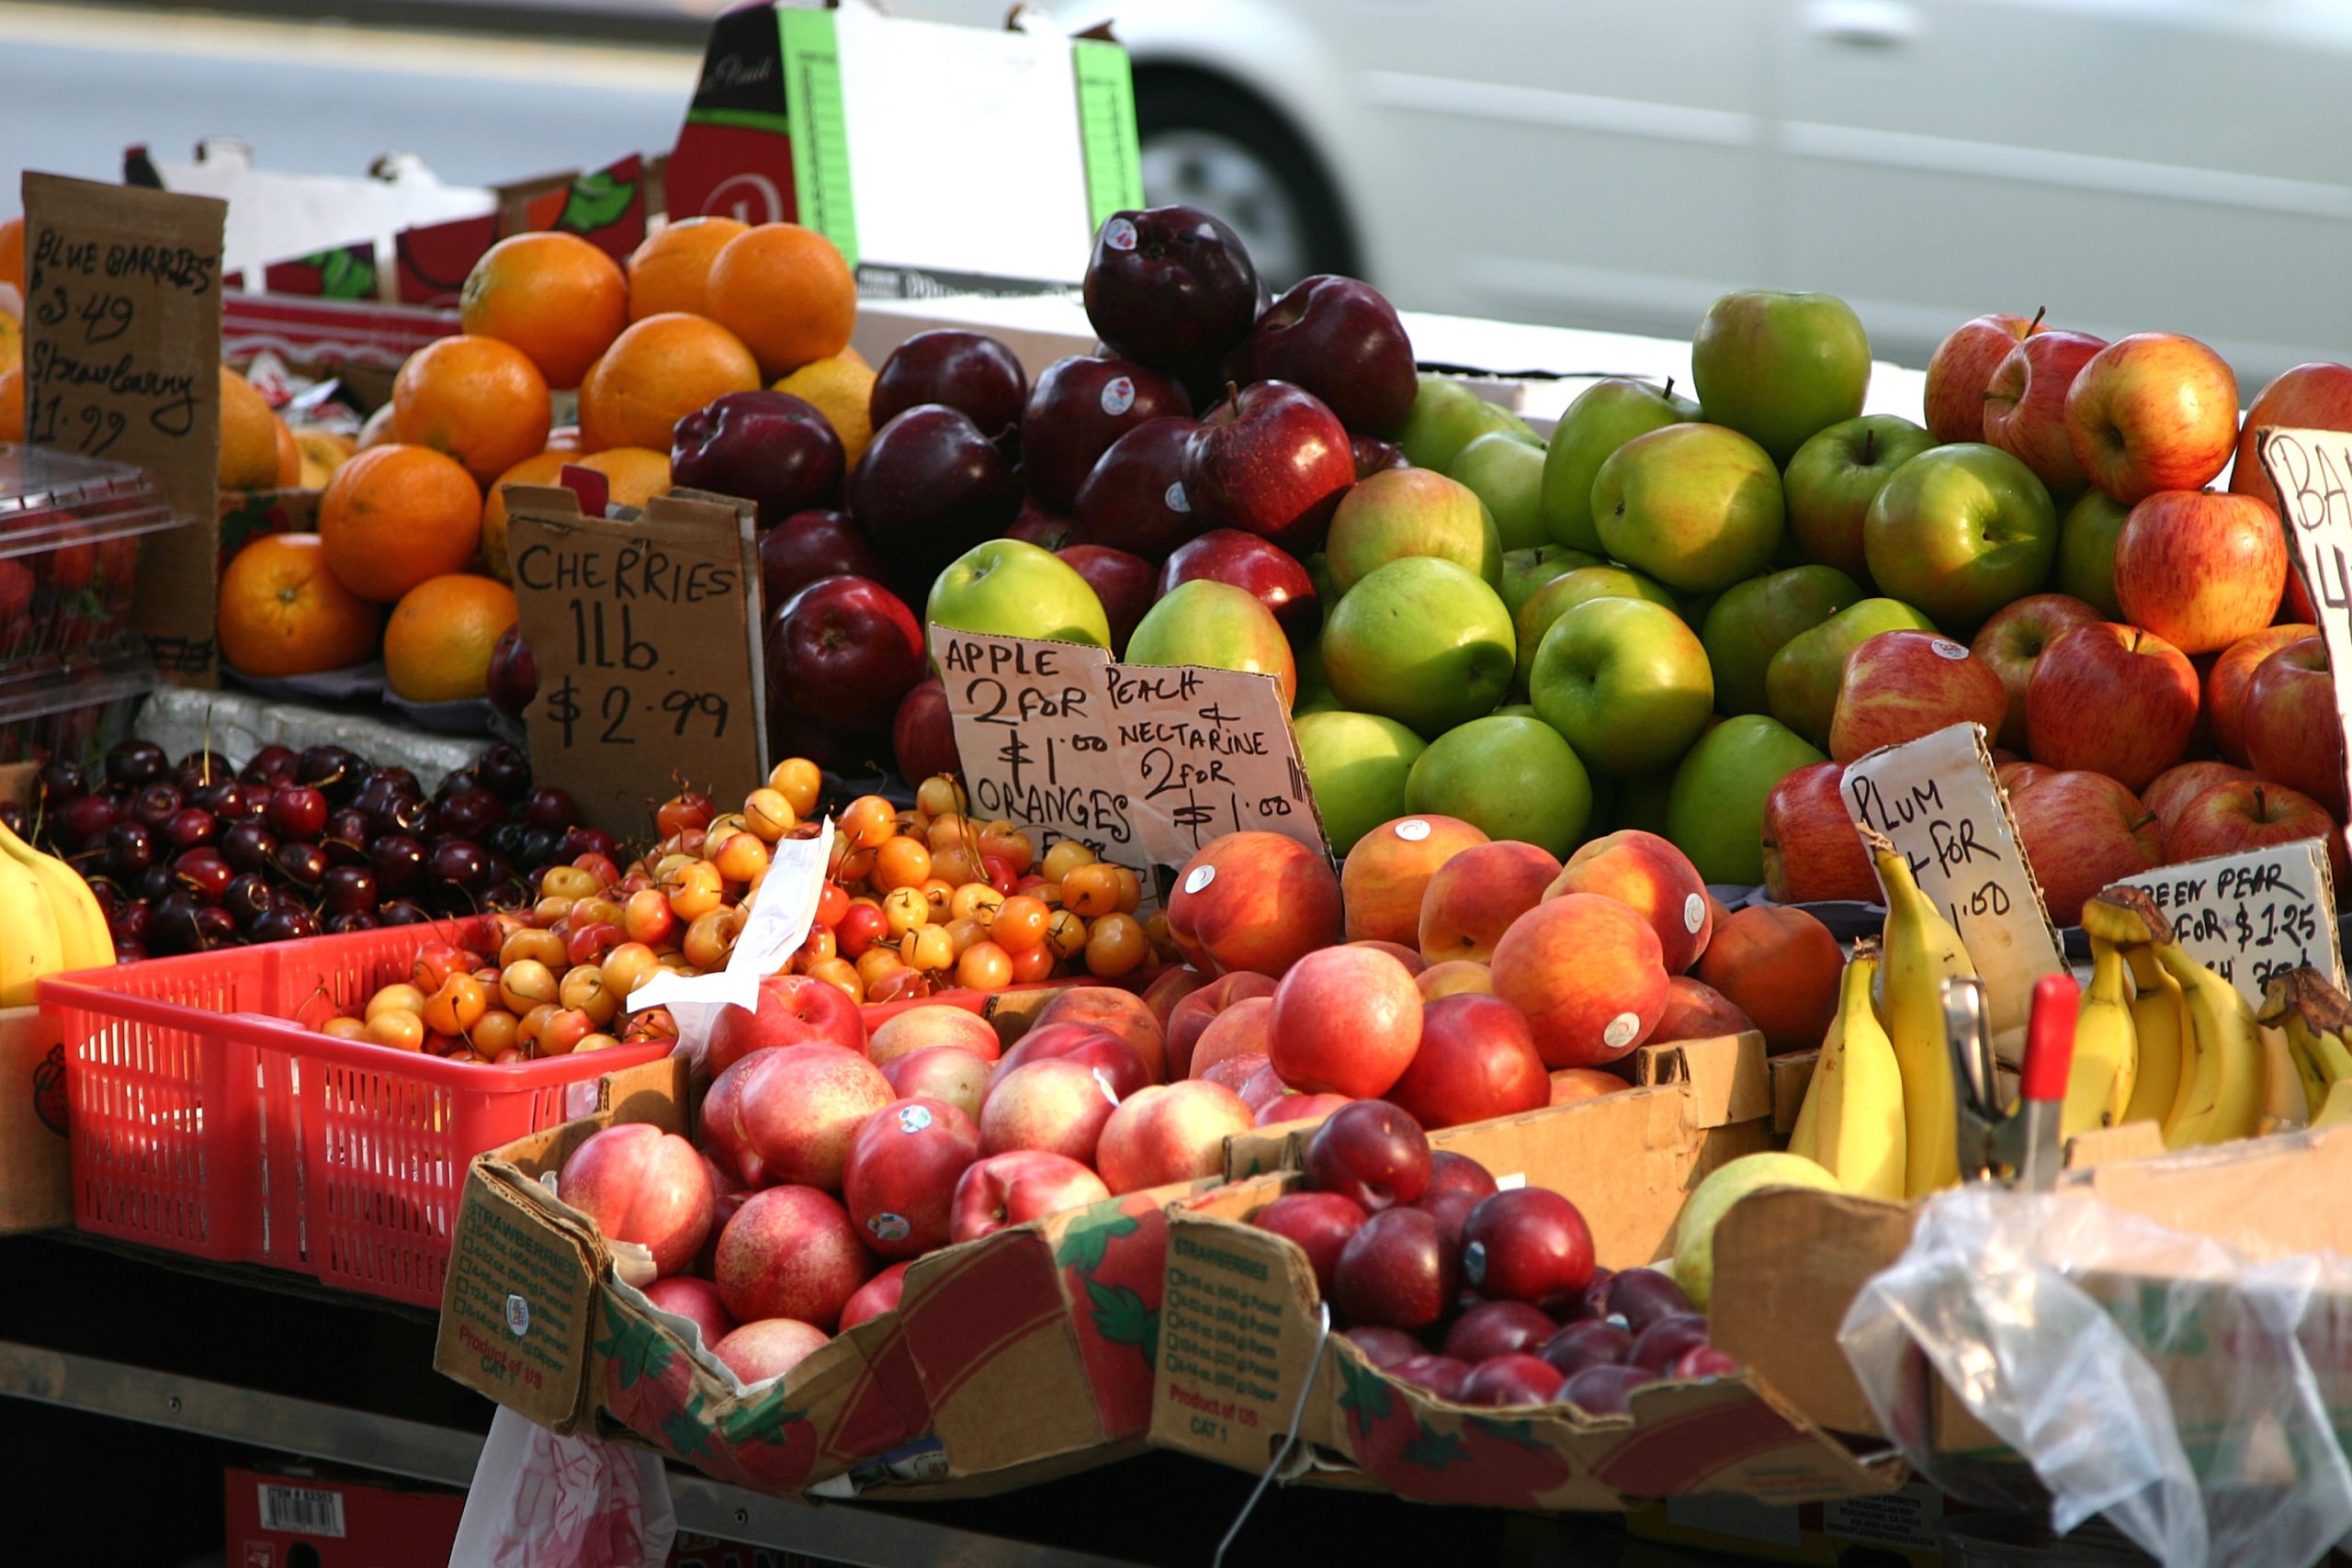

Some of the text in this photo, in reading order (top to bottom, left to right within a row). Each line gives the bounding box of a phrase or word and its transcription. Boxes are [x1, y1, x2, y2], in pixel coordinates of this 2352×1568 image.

[36, 228, 98, 277] BLUE
[2269, 435, 2352, 532] BA
[517, 544, 737, 604] CHERRIES
[945, 637, 1060, 676] APPLE
[966, 678, 1090, 726] 2 FOR
[1105, 666, 1204, 710] PEACH
[1140, 747, 1236, 800] 2 FOR
[978, 777, 1132, 844] ORANGES
[1851, 775, 1944, 831] PLUM
[1929, 818, 2001, 879] FOR
[2218, 863, 2306, 900] PEAR
[469, 1198, 579, 1280] STRAWBERRIES
[459, 1324, 507, 1365] Product
[508, 1359, 524, 1376] of
[525, 1364, 544, 1390] US
[1170, 1382, 1259, 1428] Product of US
